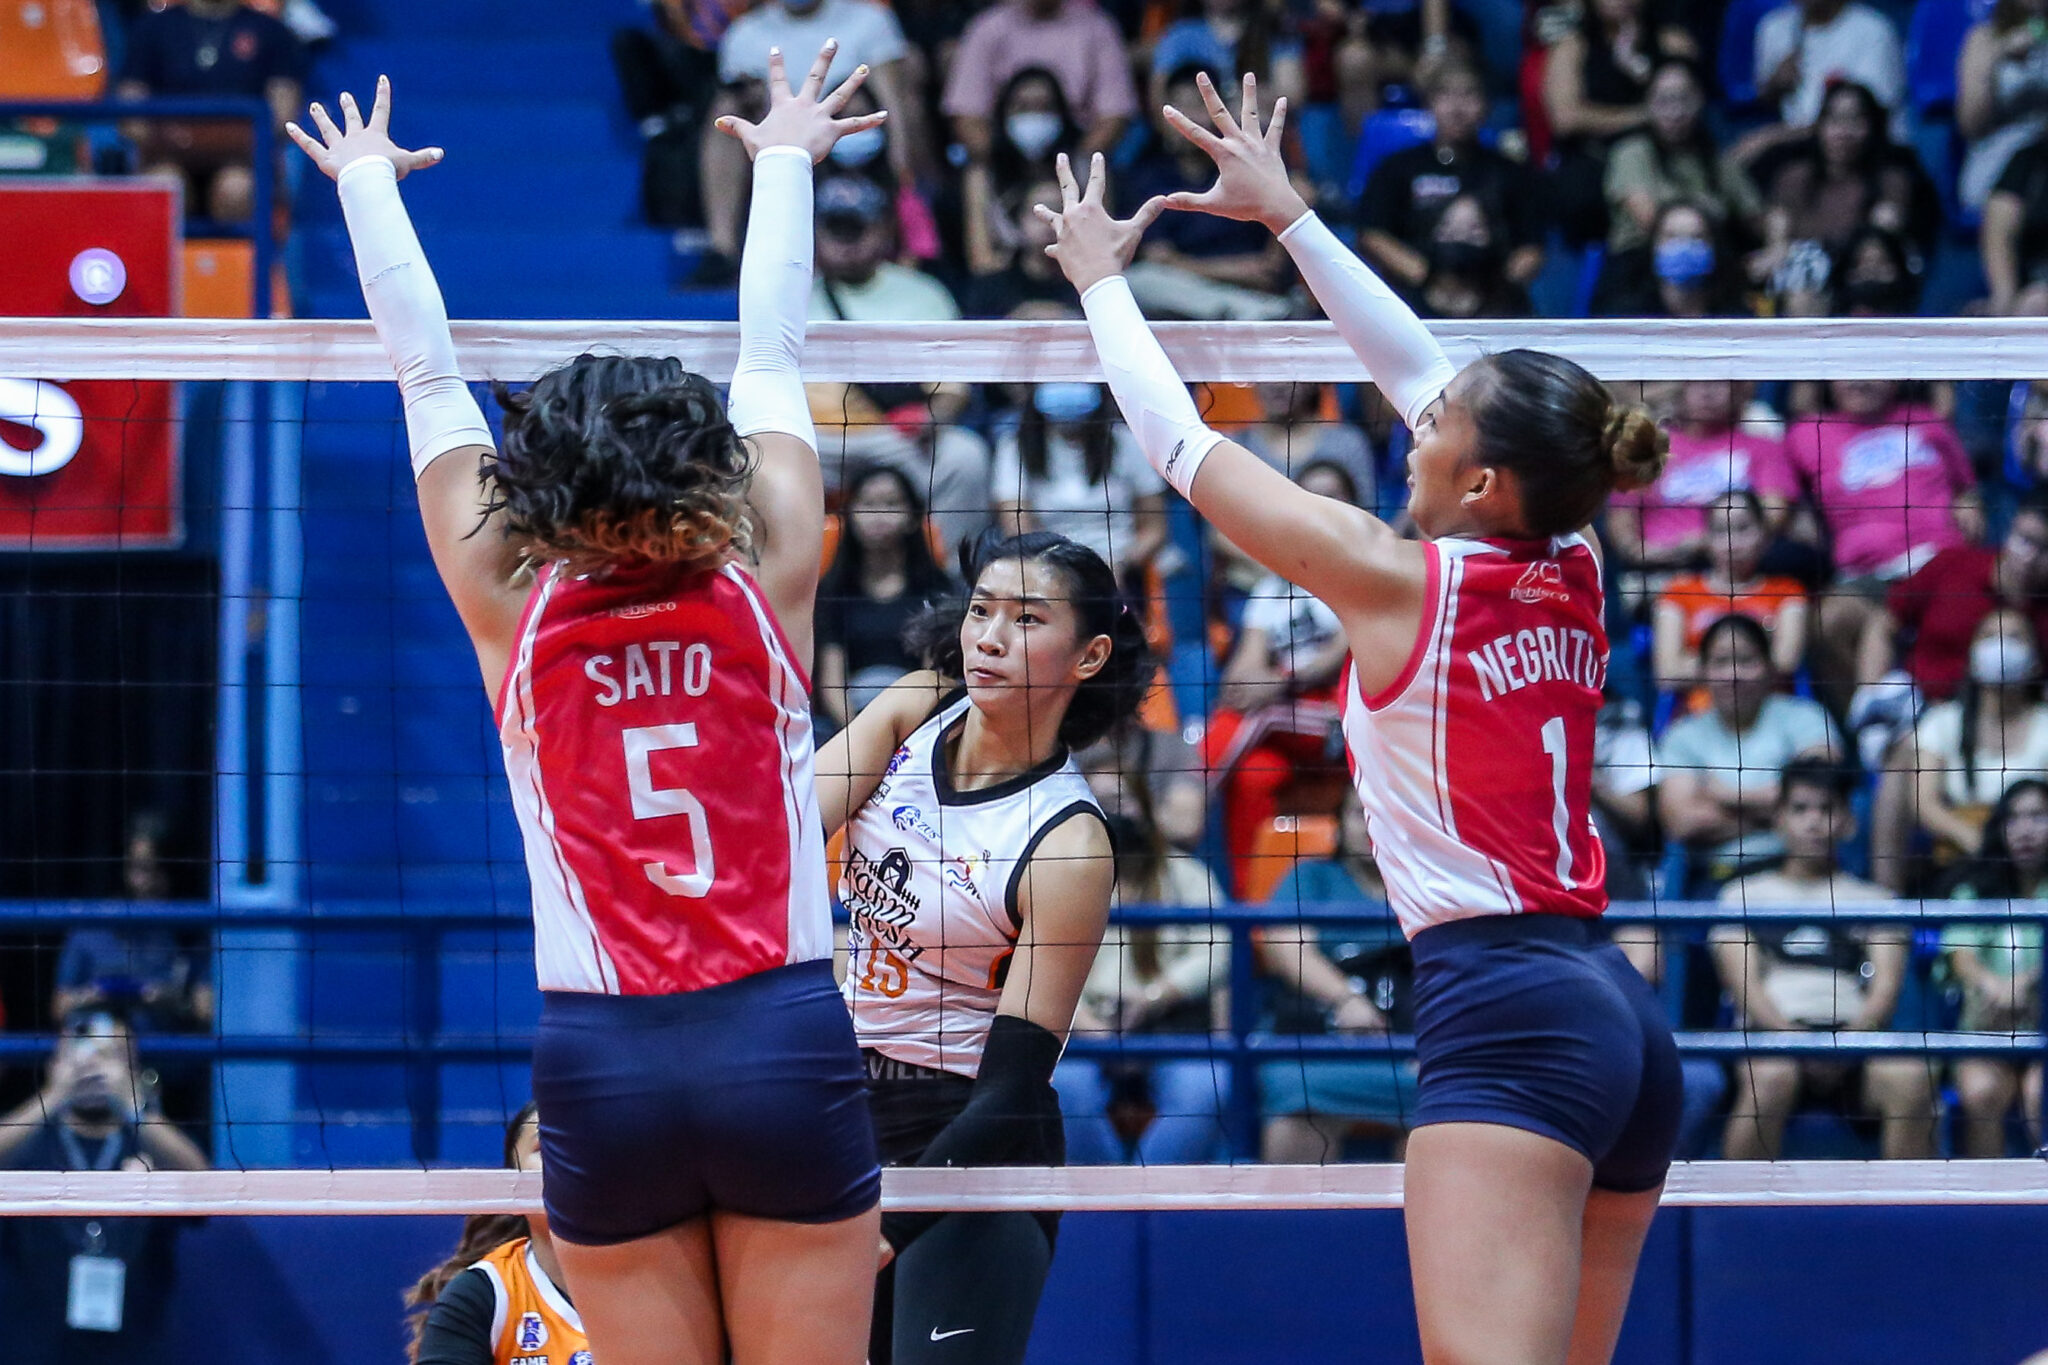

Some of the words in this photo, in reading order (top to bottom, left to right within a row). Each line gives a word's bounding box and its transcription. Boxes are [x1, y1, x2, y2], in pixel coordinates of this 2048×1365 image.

[584, 641, 712, 707] SATO
[622, 721, 716, 898] 5
[1540, 716, 1578, 891] 1
[859, 938, 909, 999] 15
